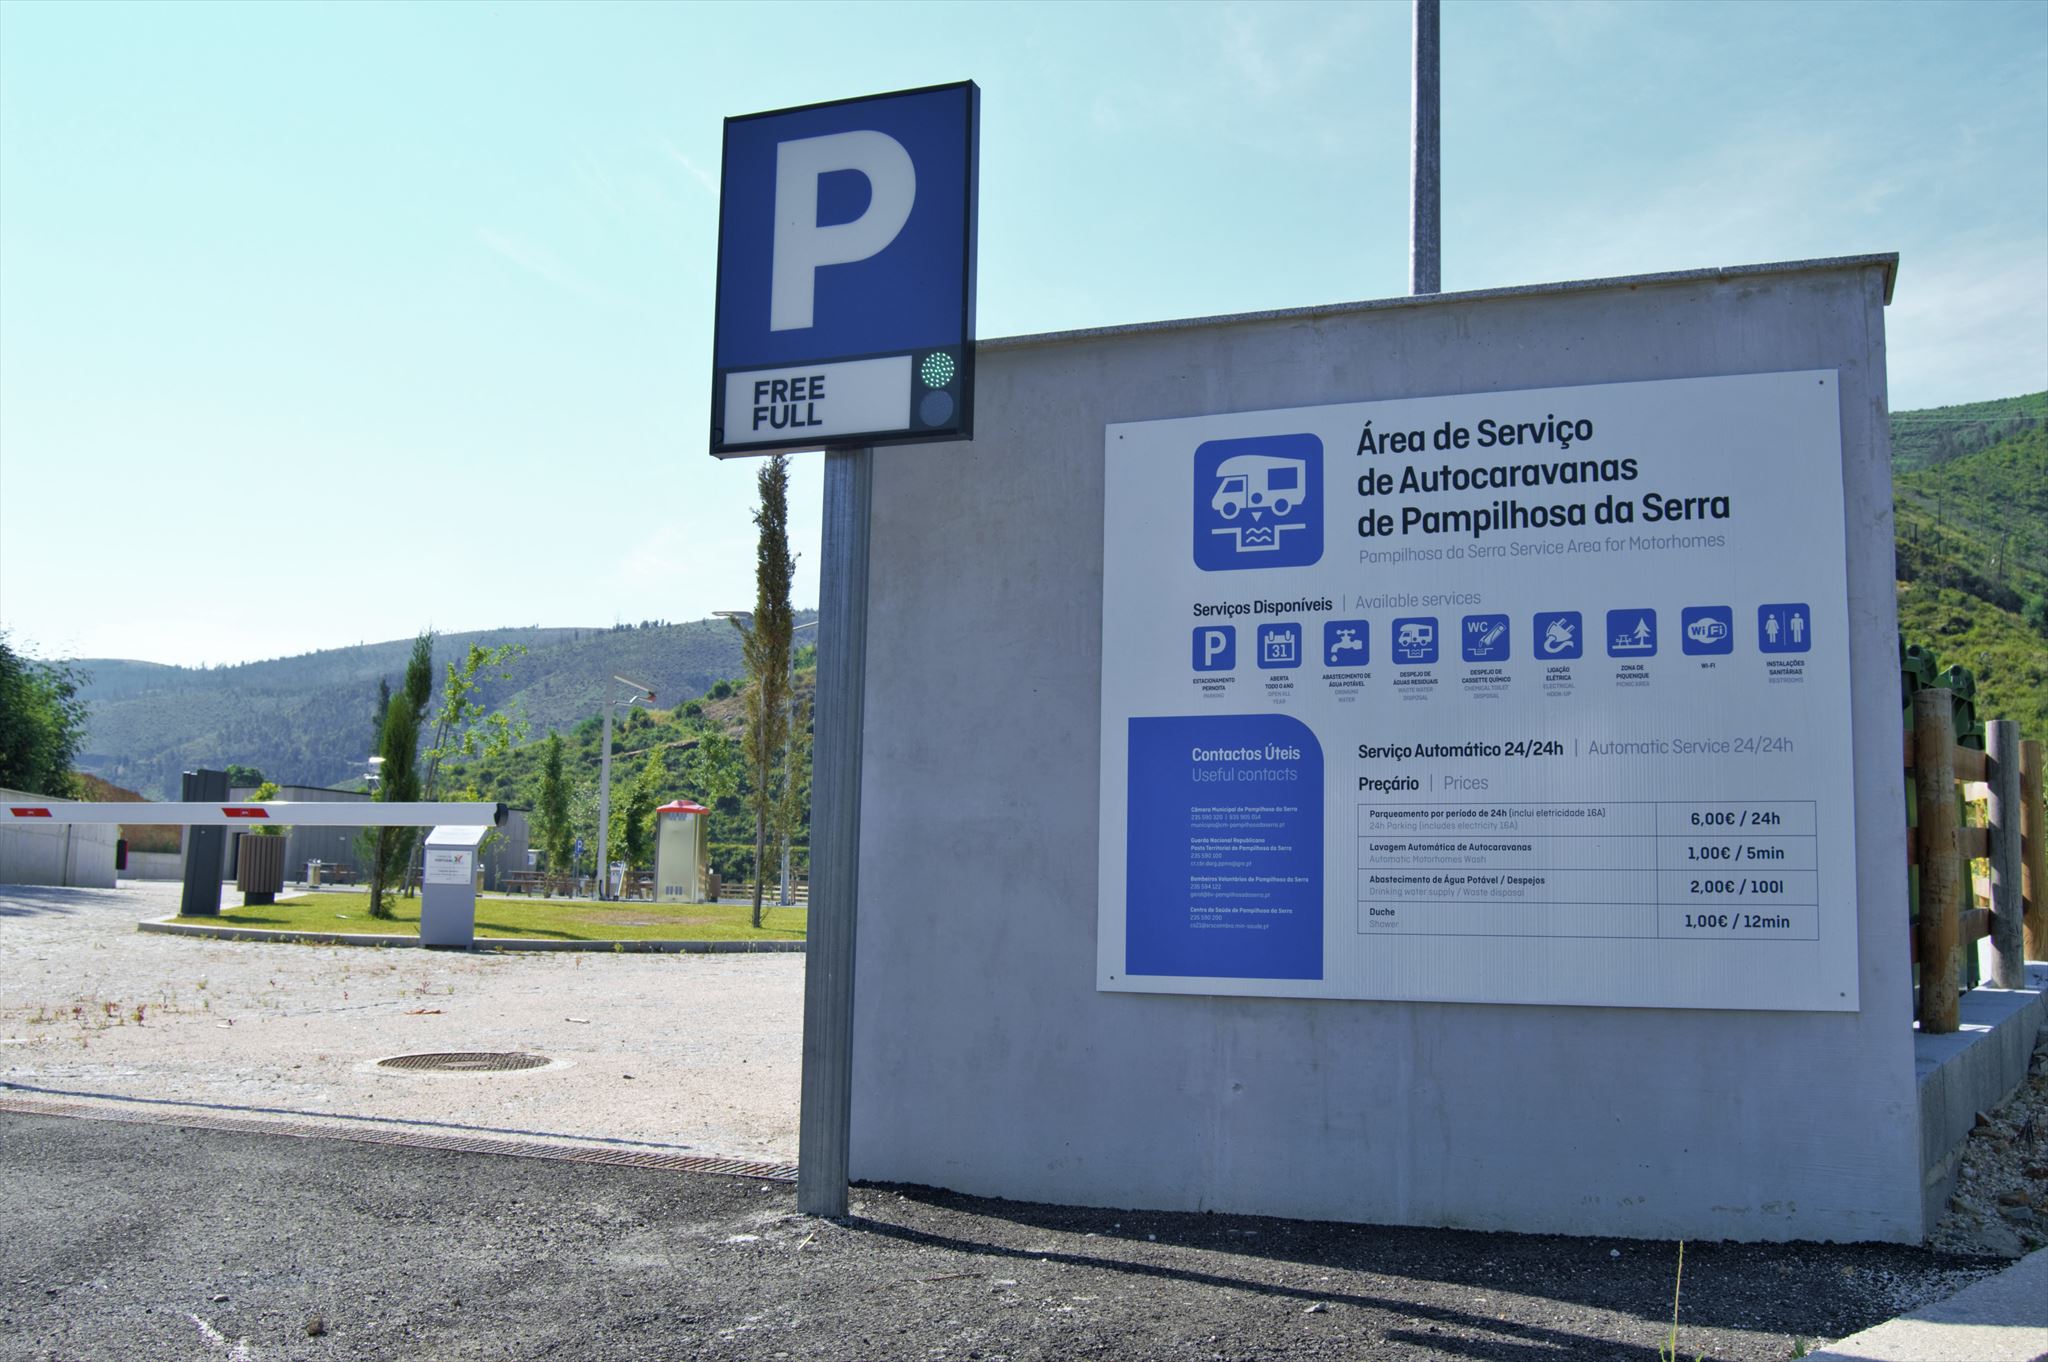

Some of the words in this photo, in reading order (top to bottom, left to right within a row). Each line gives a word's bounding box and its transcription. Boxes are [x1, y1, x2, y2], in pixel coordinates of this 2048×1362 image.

[770, 130, 916, 332] P
[754, 375, 825, 405] FREE
[752, 402, 823, 431] FULL
[1356, 420, 1426, 456] Área
[1433, 422, 1470, 450] de
[1477, 414, 1593, 449] Serviço
[1357, 468, 1394, 497] de
[1399, 457, 1638, 495] Autocaravanas
[1358, 509, 1394, 538] de
[1402, 500, 1587, 540] Pampilhosa
[1594, 496, 1634, 526] da
[1642, 492, 1730, 523] Serra
[1359, 546, 1443, 567] Pampilhosa
[1446, 544, 1464, 561] da
[1467, 542, 1506, 559] Serra
[1510, 539, 1564, 557] Service
[1567, 537, 1601, 554] Area
[1605, 535, 1625, 552] for
[1629, 532, 1725, 550] Motorhomes
[1193, 602, 1251, 619] Serviços
[1254, 597, 1333, 616] Disponíveis
[1355, 593, 1419, 610] Available
[1422, 591, 1481, 607] services
[1467, 621, 1488, 633] WC
[1204, 631, 1227, 666] P
[1271, 644, 1287, 658] 31
[1547, 666, 1570, 674] LIGAÇÃO
[1767, 659, 1805, 667] INSTALAÇÕES
[1343, 679, 1365, 687] POTÁVEL
[1192, 746, 1262, 762] Contactos
[1265, 743, 1301, 760] Úteis
[1358, 743, 1412, 762] Serviço
[1414, 741, 1501, 758] Automático
[1504, 739, 1564, 758] 24/24h
[1588, 739, 1669, 755] Automatic
[1673, 738, 1730, 754] Service
[1734, 736, 1793, 755] 24/24h
[1192, 767, 1234, 782] Useful
[1238, 767, 1298, 781] contacts
[1358, 776, 1419, 794] Preçário
[1444, 775, 1489, 791] Prices
[1369, 810, 1429, 819] Parqueamento
[1430, 810, 1443, 819] por
[1446, 808, 1476, 819] período
[1478, 809, 1489, 817] de
[1490, 809, 1507, 817] 24h
[1508, 808, 1534, 818] (inclui
[1536, 808, 1585, 817] eletricidade
[1587, 808, 1606, 818] 16A)
[1690, 812, 1735, 827] 6,00€
[1739, 810, 1747, 827] /
[1751, 811, 1781, 825] 24h
[1369, 822, 1385, 830] 24h
[1387, 822, 1417, 831] Parking
[1457, 821, 1498, 831] electricity
[1369, 843, 1406, 853] Lavagem
[1408, 842, 1455, 851] Automática
[1457, 843, 1467, 851] de
[1468, 843, 1532, 851] Autocaravanas
[1688, 846, 1731, 861] 1,00€
[1735, 845, 1743, 861] /
[1746, 846, 1785, 860] 5min
[1369, 855, 1410, 863] Automatic
[1412, 855, 1462, 863] Motorhomes
[1464, 855, 1486, 863] Wash
[1369, 875, 1431, 884] Abastecimento
[1432, 875, 1442, 884] de
[1444, 874, 1465, 885] Água
[1467, 875, 1498, 884] Potável
[1507, 875, 1545, 886] Despejos
[1690, 880, 1735, 895] 2,00€
[1739, 878, 1747, 895] /
[1751, 879, 1784, 893] 100l
[1369, 887, 1402, 897] Drinking
[1404, 888, 1426, 896] water
[1428, 887, 1455, 897] supply
[1463, 888, 1488, 896] Waste
[1490, 887, 1525, 897] disposal
[1369, 907, 1395, 916] Duche
[1369, 920, 1399, 928] Shower
[1685, 914, 1728, 929] 1,00€
[1732, 913, 1740, 930] /
[1744, 914, 1790, 928] 12min
